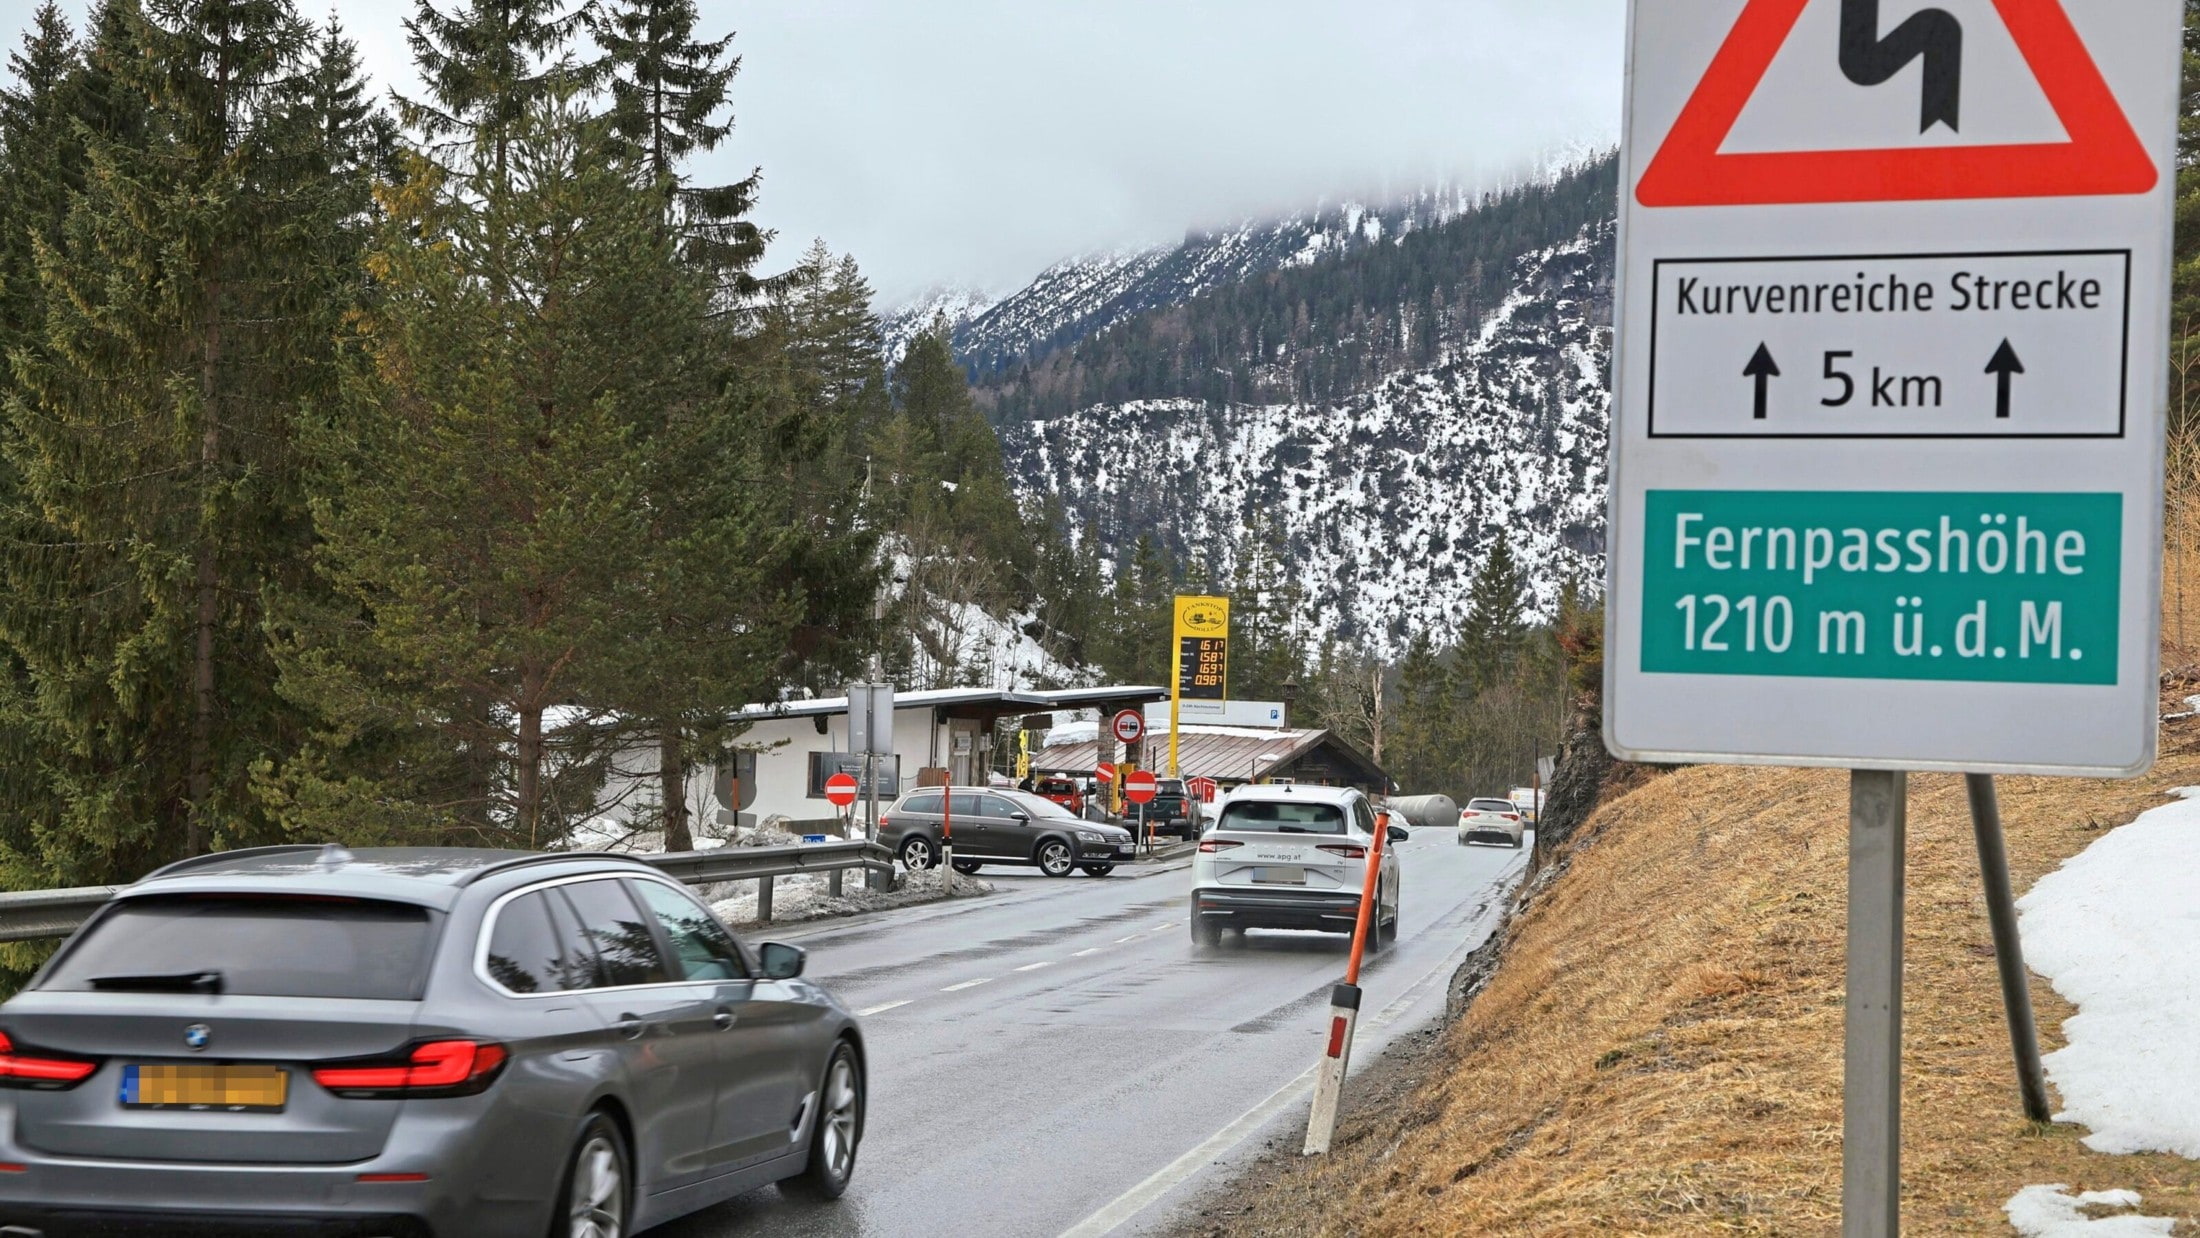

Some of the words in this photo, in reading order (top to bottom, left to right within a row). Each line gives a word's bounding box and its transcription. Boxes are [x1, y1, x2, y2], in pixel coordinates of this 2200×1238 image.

[1677, 271, 1934, 315] Kurvenreiche
[1949, 270, 2101, 312] Strecke
[1820, 350, 1856, 408] 5
[1871, 366, 1942, 407] km
[1675, 513, 2085, 585] Fernpasshöhe
[1675, 594, 1793, 653] 1210
[1818, 610, 1866, 654] m
